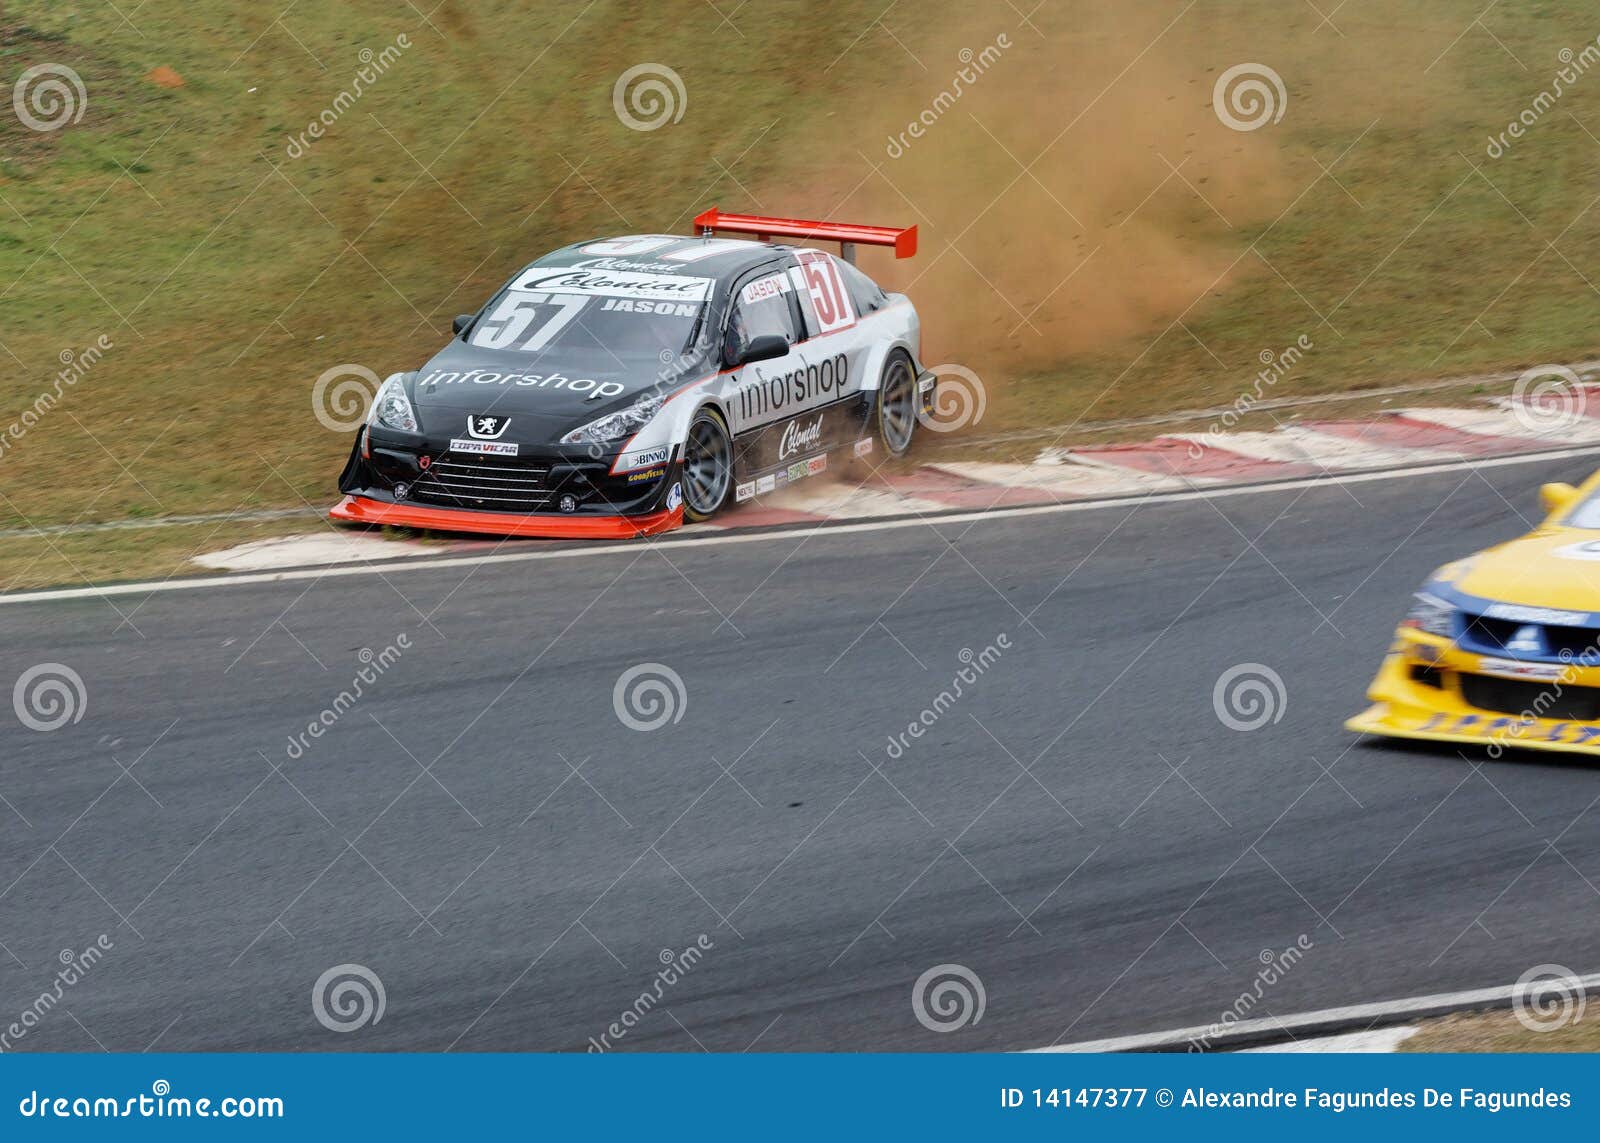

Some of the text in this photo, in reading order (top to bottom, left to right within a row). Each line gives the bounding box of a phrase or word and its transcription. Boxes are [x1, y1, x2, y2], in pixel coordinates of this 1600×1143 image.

[523, 271, 705, 293] Colonial
[748, 279, 784, 301] JASON
[802, 260, 848, 326] 57
[472, 292, 592, 351] 57
[600, 299, 698, 318] JASON
[419, 369, 625, 399] inforshop
[739, 353, 849, 420] inforshop
[778, 413, 824, 461] Colonial
